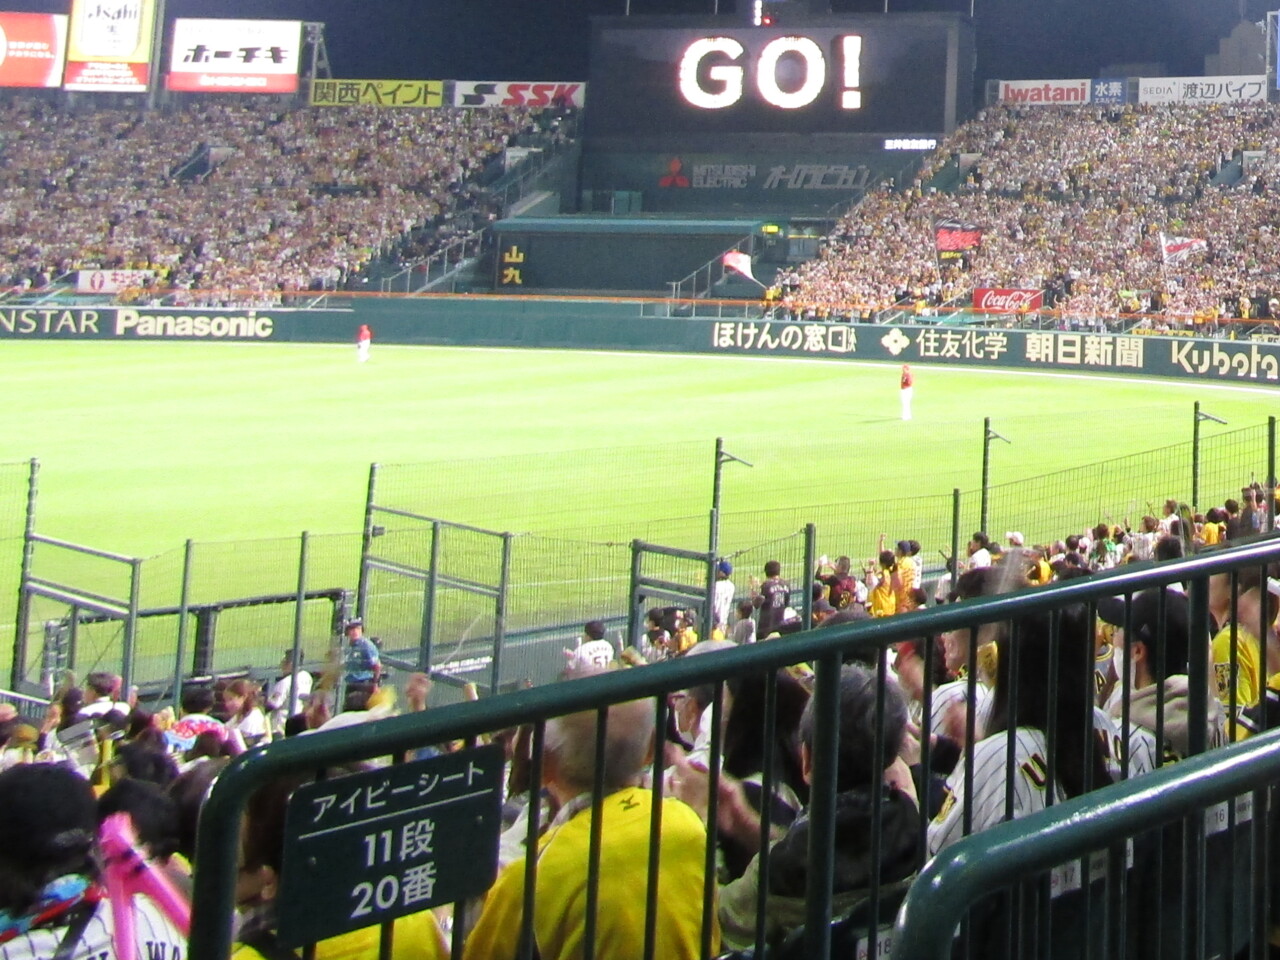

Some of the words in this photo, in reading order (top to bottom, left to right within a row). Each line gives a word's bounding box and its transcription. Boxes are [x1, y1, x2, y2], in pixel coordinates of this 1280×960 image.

[183, 45, 288, 64] ホーチキ
[679, 36, 861, 109] GO!
[313, 81, 441, 105] 関西ペイント
[501, 83, 582, 107] SSK
[1003, 82, 1087, 103] Iwatani
[1095, 82, 1122, 97] 水素
[503, 245, 525, 284] 山九
[115, 310, 274, 337] Panasonic
[713, 321, 852, 353] ほけんの窓口
[917, 330, 1008, 361] 住友化学
[1025, 333, 1145, 368] 朝日新聞
[1171, 340, 1279, 380] Kubota
[312, 761, 485, 823] アイビーシート
[364, 818, 436, 867] 11段
[350, 861, 437, 918] 20番
